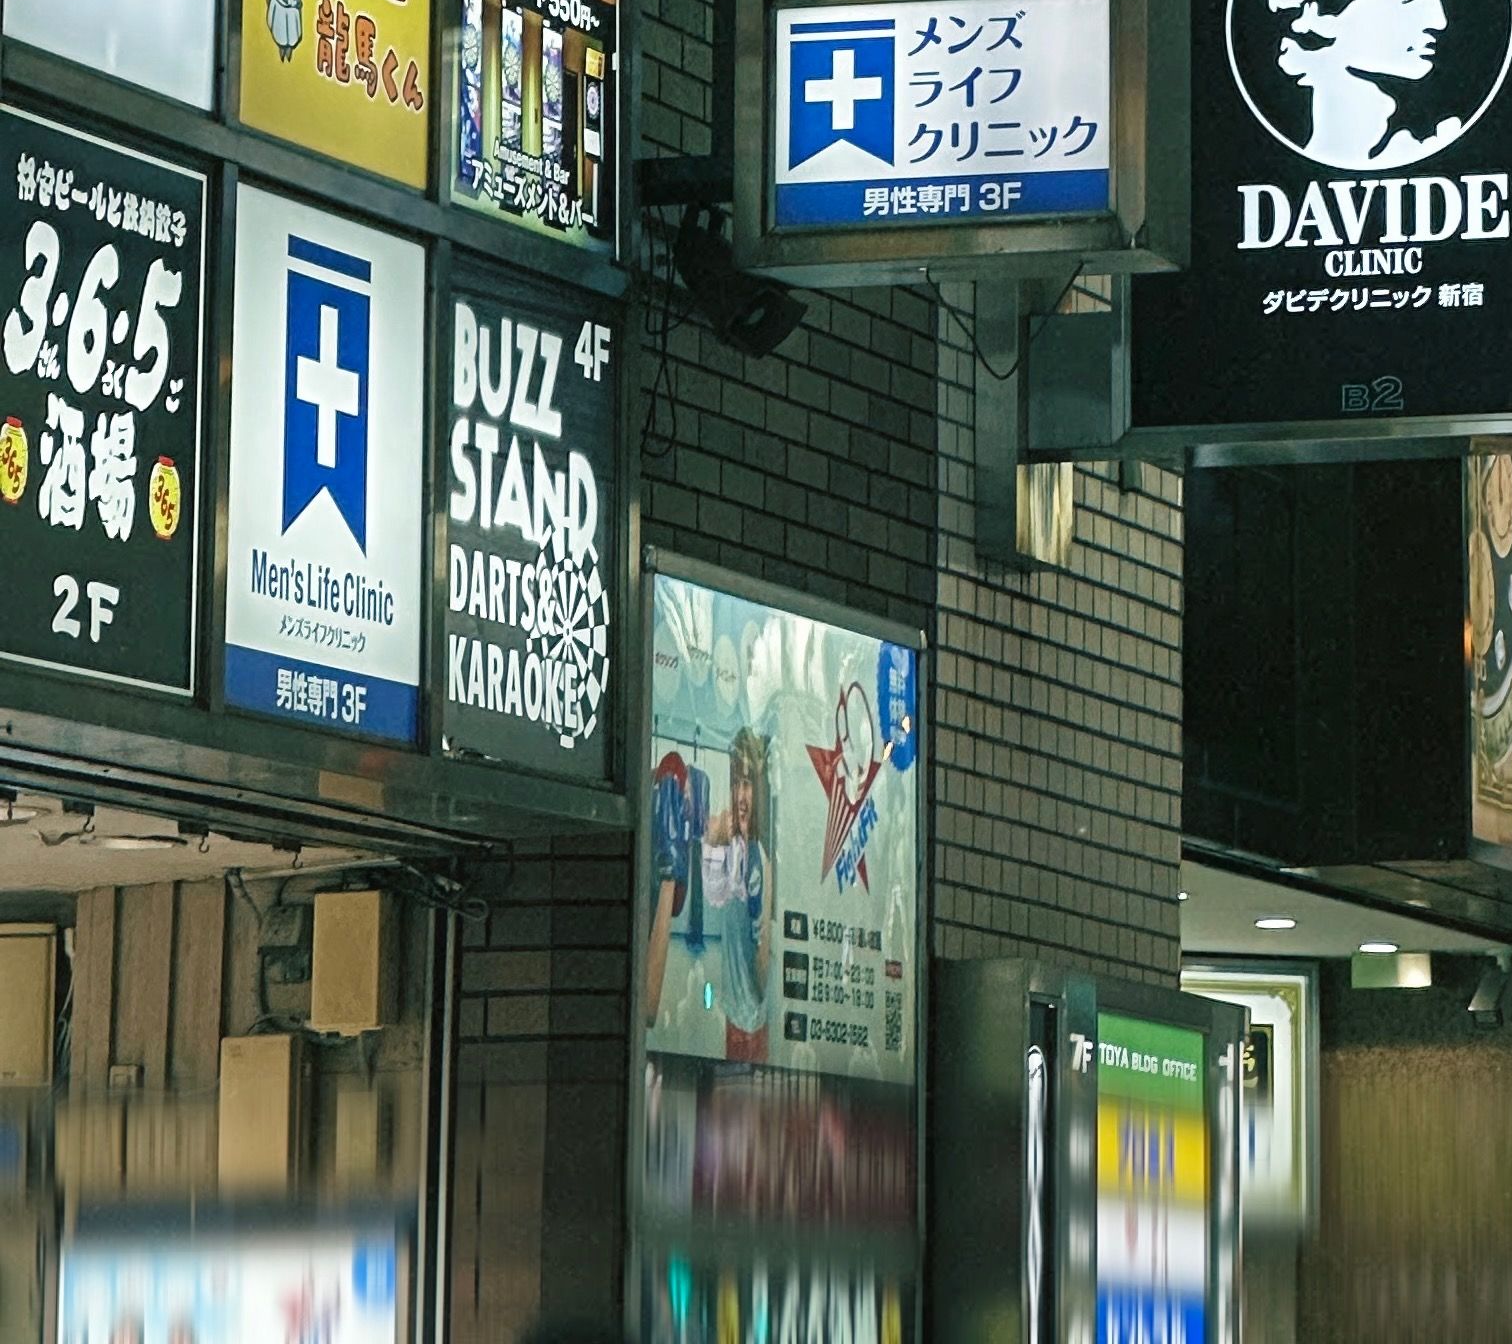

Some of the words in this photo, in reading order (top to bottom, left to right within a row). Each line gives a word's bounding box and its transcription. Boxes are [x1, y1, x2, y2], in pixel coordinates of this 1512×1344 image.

[907, 8, 1026, 57] メンズ
[907, 67, 1022, 109] ライフ
[907, 115, 1099, 164] クリニック
[862, 183, 971, 216] 男性専門
[978, 181, 1022, 211] 3F
[1237, 173, 1511, 250] DAVIDE
[1323, 246, 1423, 279] CLINIC
[1262, 285, 1433, 315] ダビデクリニック
[1438, 282, 1485, 309] 新宿
[453, 301, 563, 436] BUZZ
[573, 321, 611, 385] 4F
[1341, 375, 1405, 412] B2
[449, 418, 600, 562] STAND
[51, 574, 121, 644] 2F
[250, 548, 304, 605] Men's
[307, 562, 341, 614] Life
[343, 571, 395, 626] Clinic
[278, 613, 367, 654] メンズライフクリニック
[275, 667, 339, 721] 男性専門
[341, 681, 368, 725] 3F
[448, 633, 581, 731] KARAOKE
[1098, 1042, 1129, 1070] TOYA
